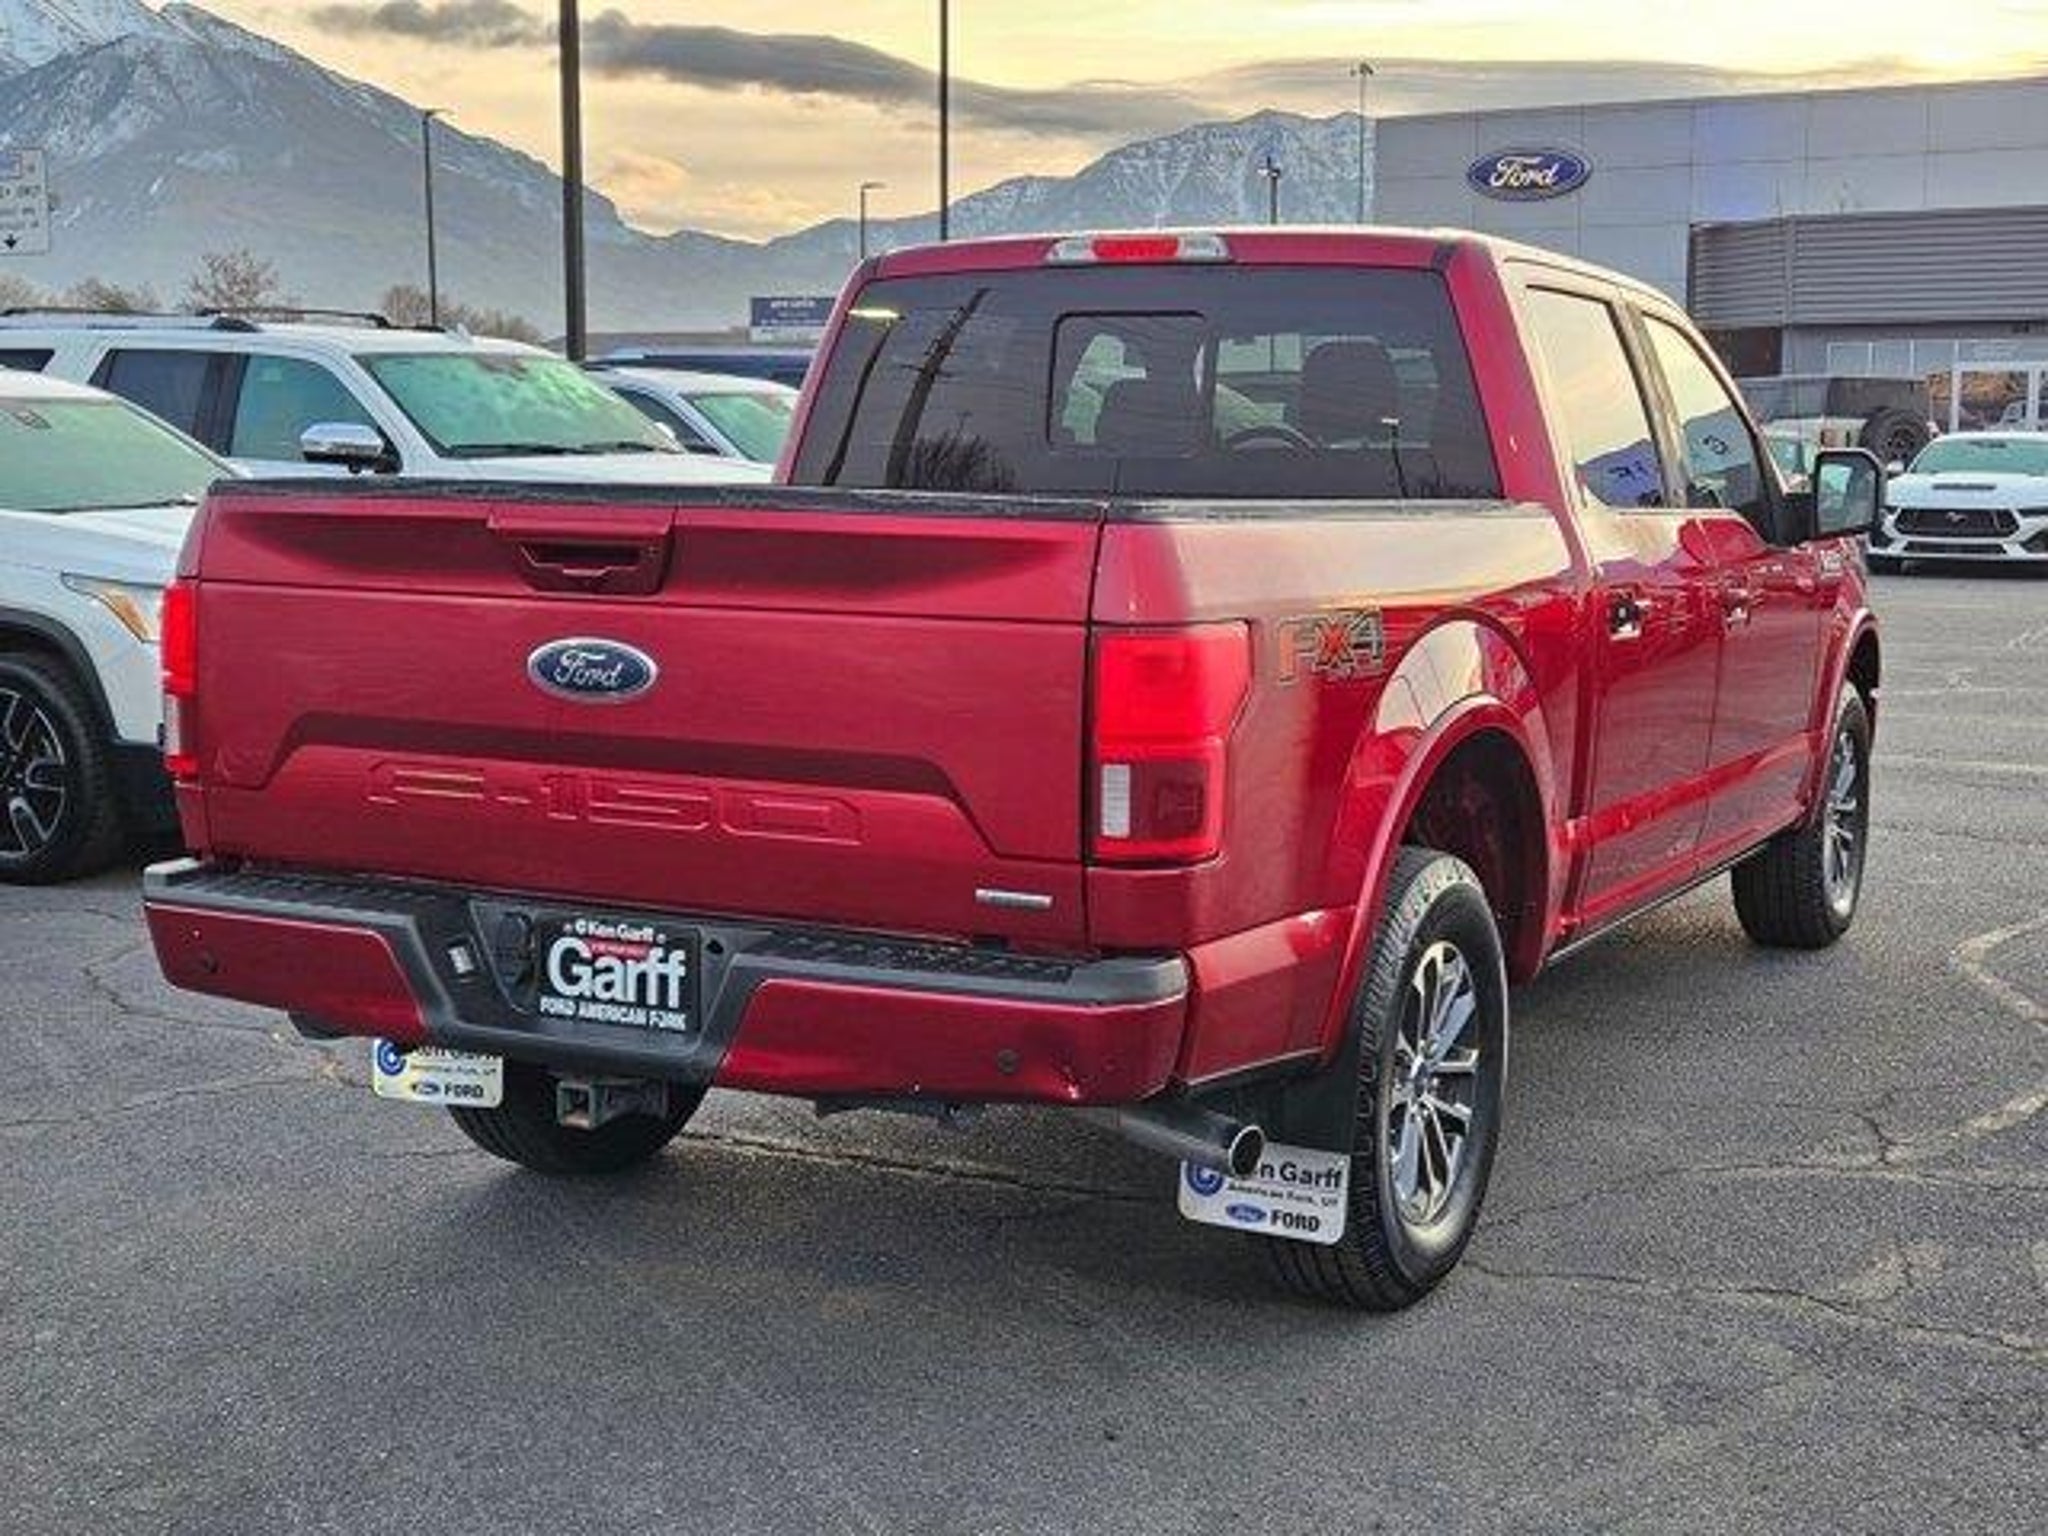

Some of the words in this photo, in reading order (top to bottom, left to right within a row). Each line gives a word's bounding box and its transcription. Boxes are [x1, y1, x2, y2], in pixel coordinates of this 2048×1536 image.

[1489, 155, 1562, 189] Ford
[1277, 609, 1383, 685] FX4
[552, 648, 624, 688] Ford
[366, 758, 865, 846] F-150
[588, 920, 616, 938] Ken
[616, 923, 654, 943] Garff
[548, 936, 687, 1009] Garff
[540, 996, 577, 1016] FORD
[578, 1001, 648, 1026] AMERICAN
[649, 1009, 687, 1031] FORK
[444, 1082, 485, 1098] FORD
[1279, 1161, 1343, 1189] Garff
[1269, 1208, 1321, 1233] FORD
